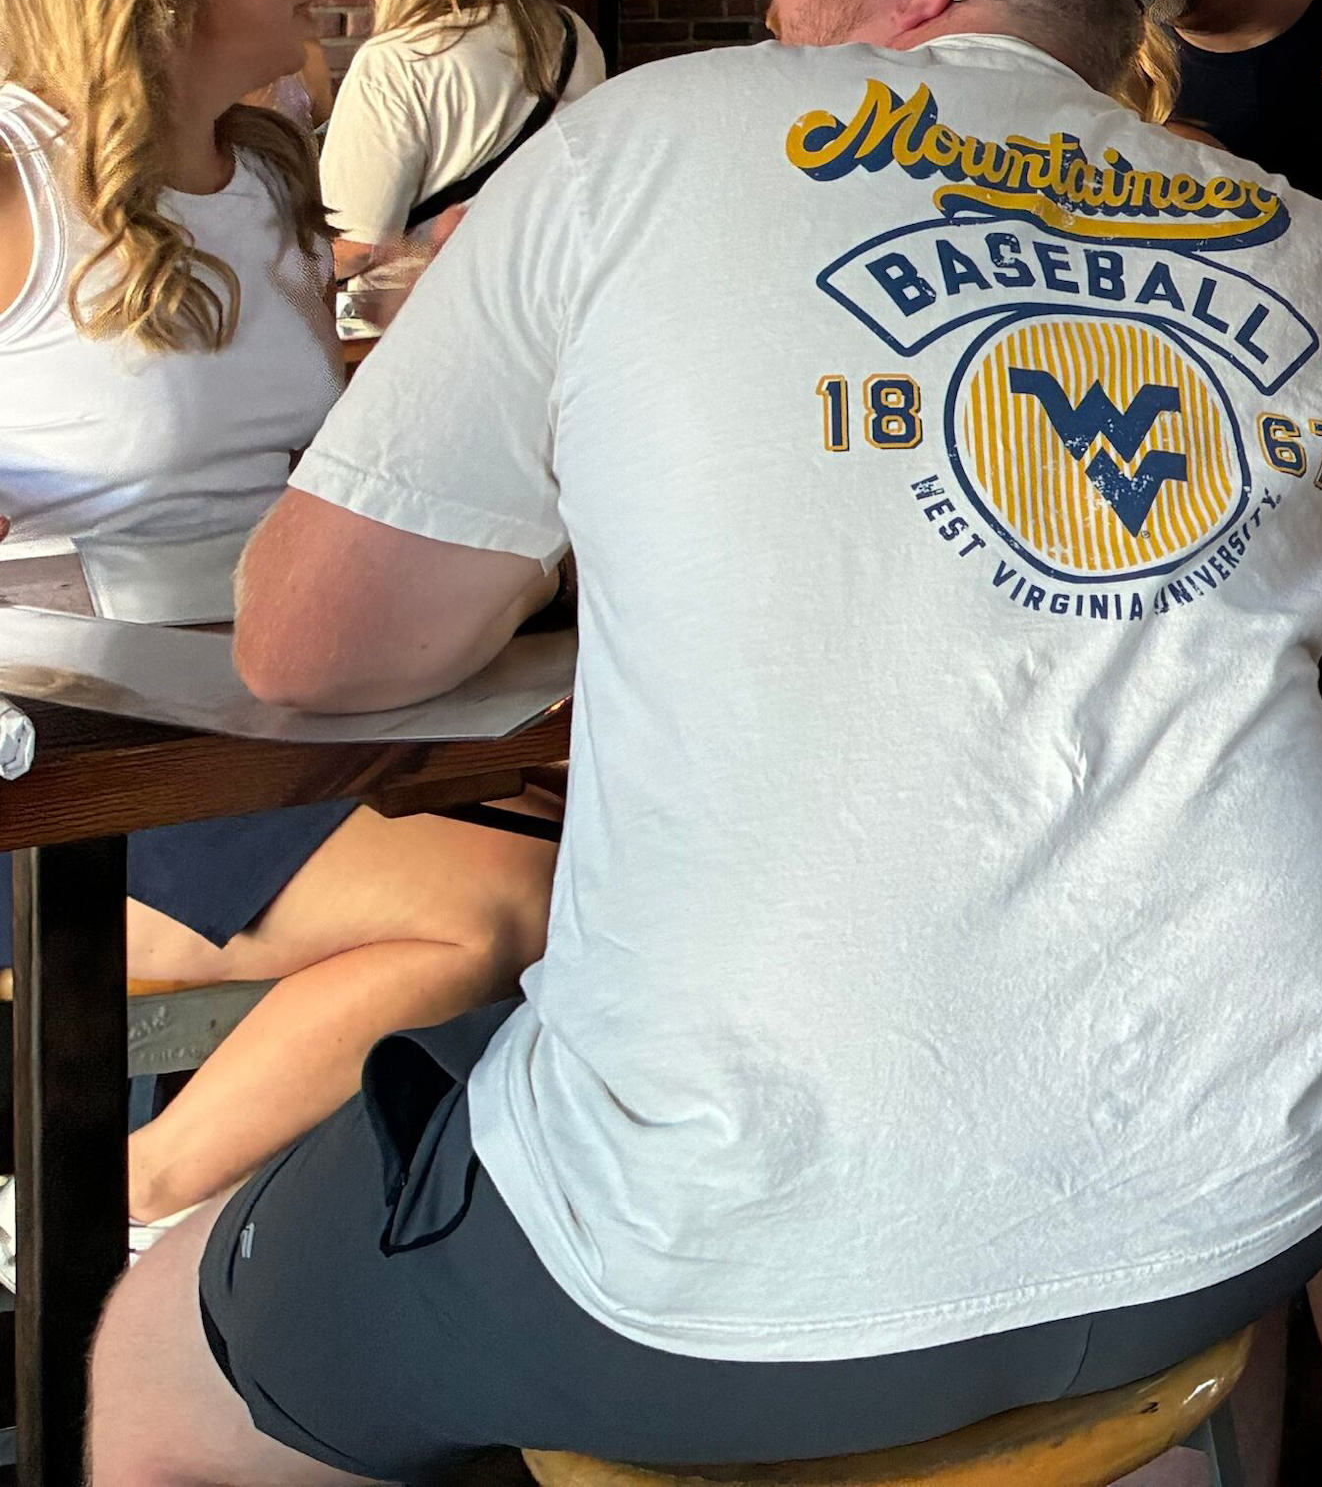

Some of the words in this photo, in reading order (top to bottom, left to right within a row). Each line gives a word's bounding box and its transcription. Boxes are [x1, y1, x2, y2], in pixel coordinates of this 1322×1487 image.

[785, 78, 1285, 219] Mountaineer
[865, 233, 1271, 365] BASEBALL
[816, 374, 923, 452] 18
[910, 474, 987, 558] WEST
[992, 560, 1143, 621] VIRGINIA
[1153, 490, 1280, 616] UNIVERSITY
